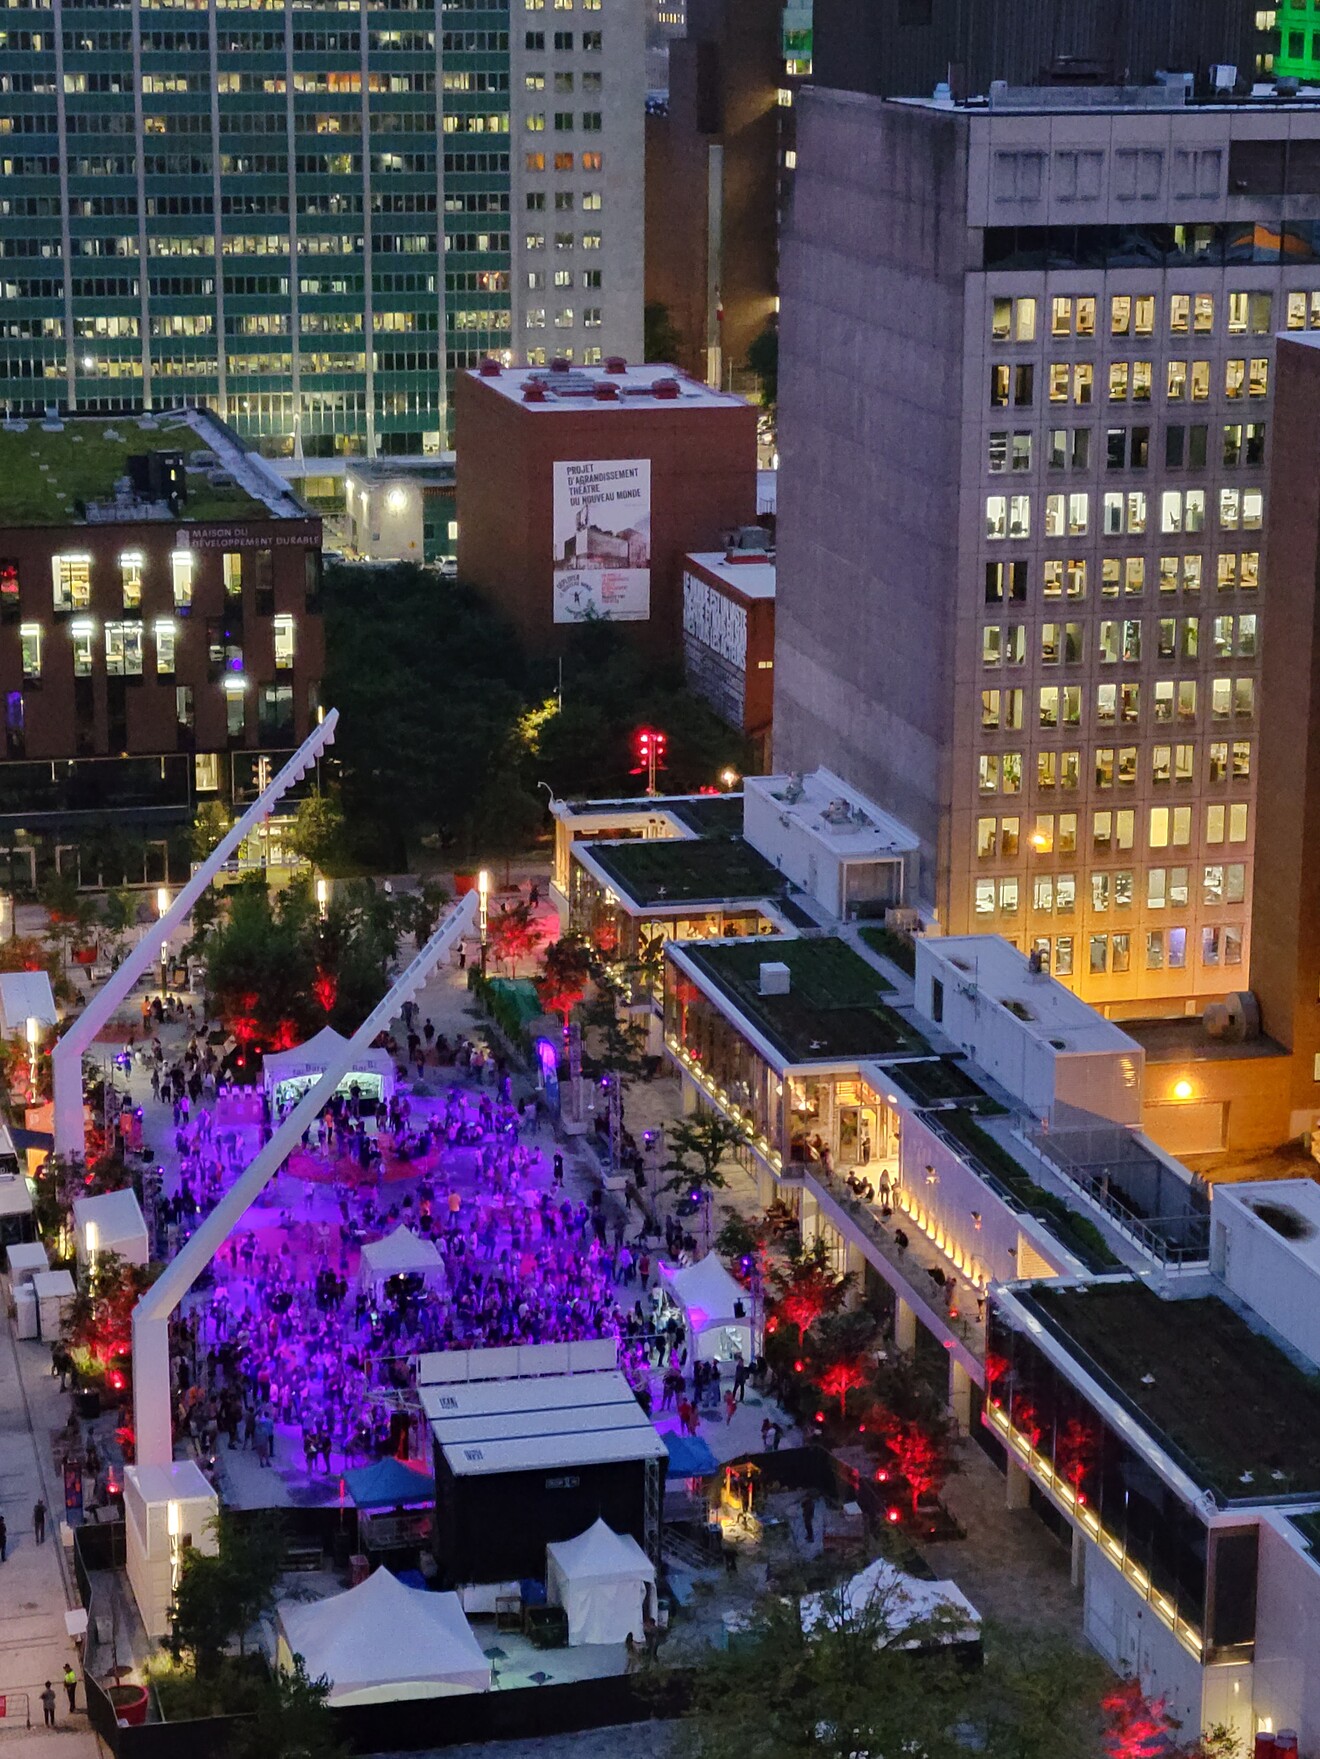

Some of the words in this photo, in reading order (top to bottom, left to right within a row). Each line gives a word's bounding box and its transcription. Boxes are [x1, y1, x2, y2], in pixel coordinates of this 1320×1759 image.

[567, 464, 593, 475] PROJET
[568, 468, 638, 486] D'AGRANDISSEMENT
[570, 497, 580, 506] DU
[582, 492, 614, 505] NOUVEAU
[617, 488, 640, 499] MONDE
[192, 529, 232, 538] MAISON
[234, 528, 248, 536] DU
[276, 536, 320, 545] DURABLE
